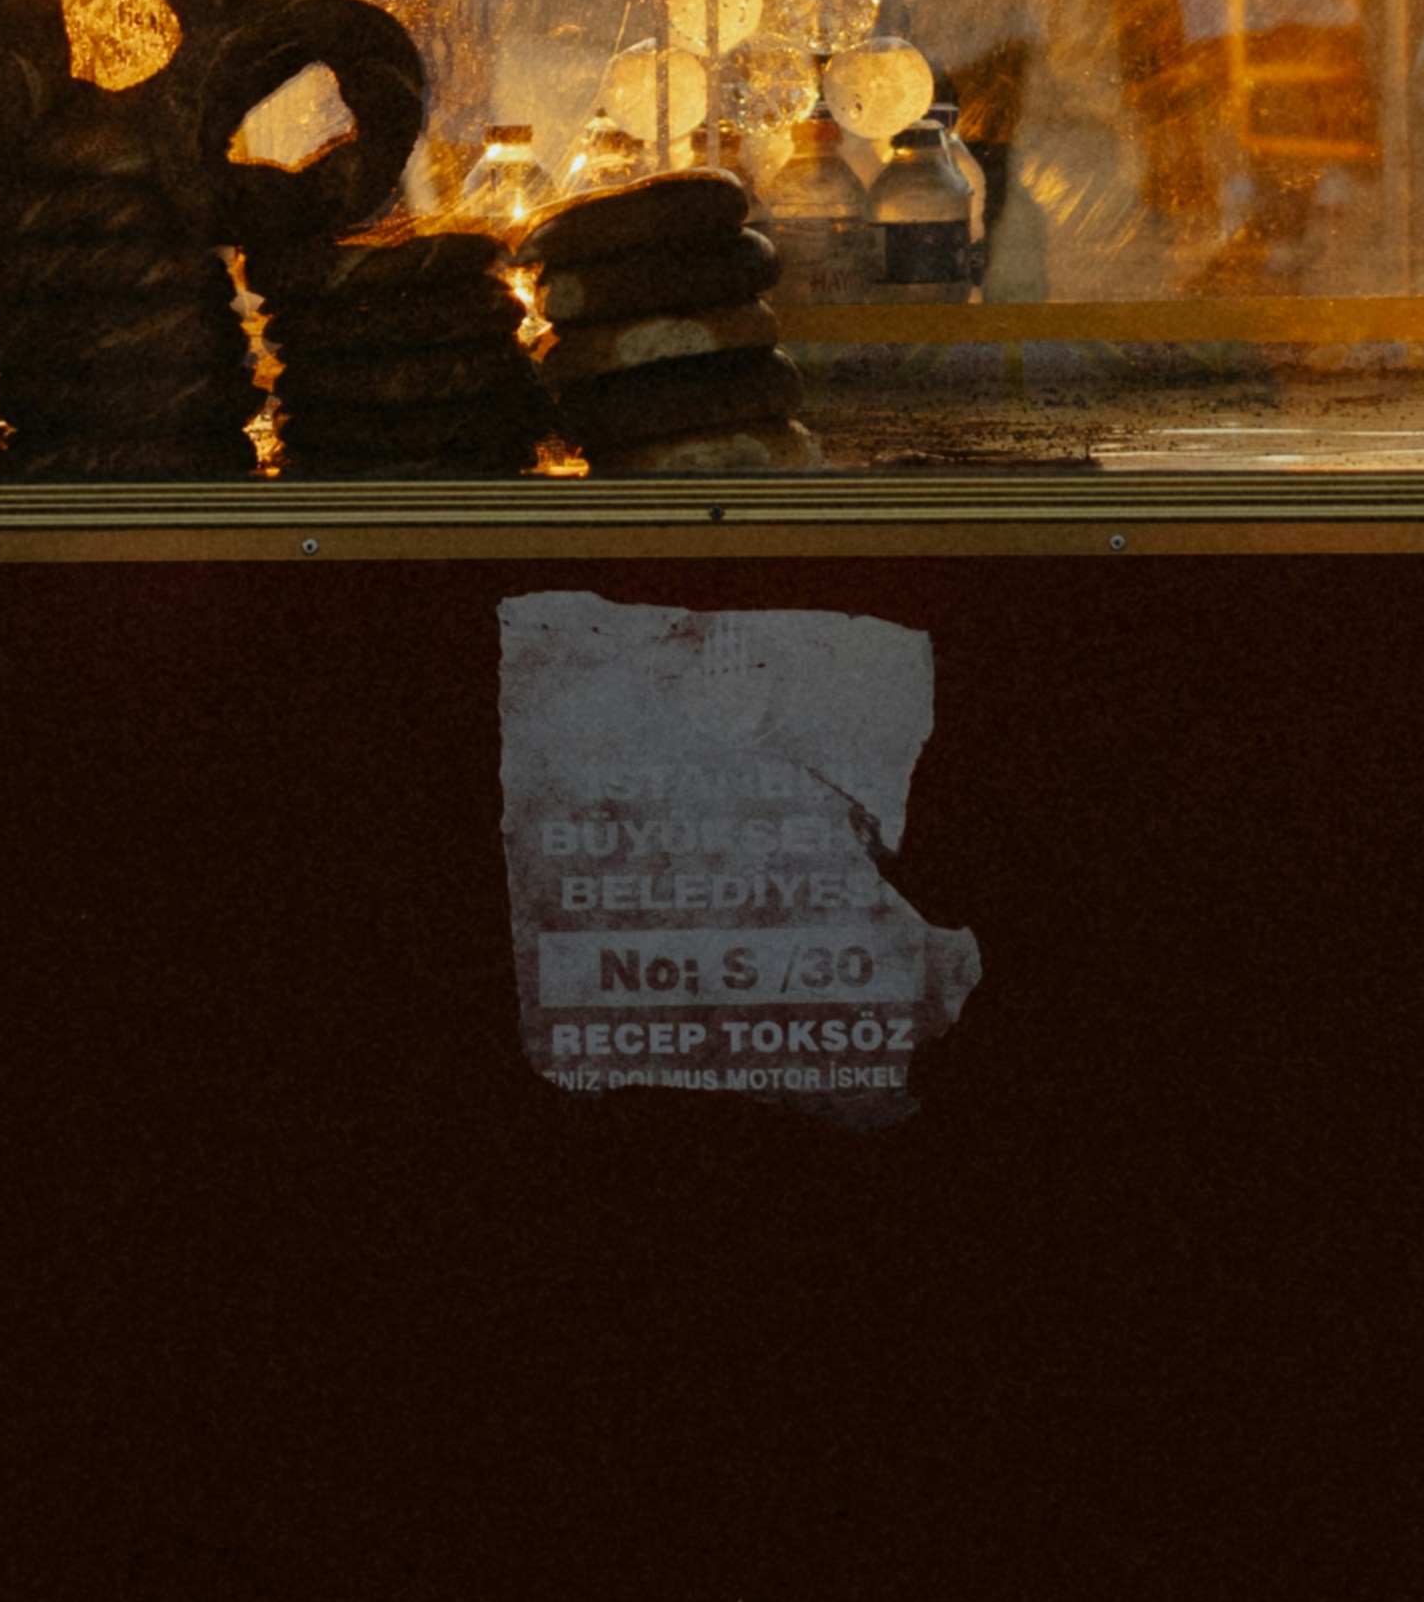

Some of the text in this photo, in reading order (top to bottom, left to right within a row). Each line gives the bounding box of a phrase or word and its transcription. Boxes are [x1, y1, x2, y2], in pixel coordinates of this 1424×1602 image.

[721, 946, 759, 990] S
[551, 1011, 914, 1056] RECEP TOKSÖZ
[542, 1065, 601, 1091] NİZ
[725, 1067, 821, 1091] MOTOR
[829, 1060, 907, 1089] İSKEL
